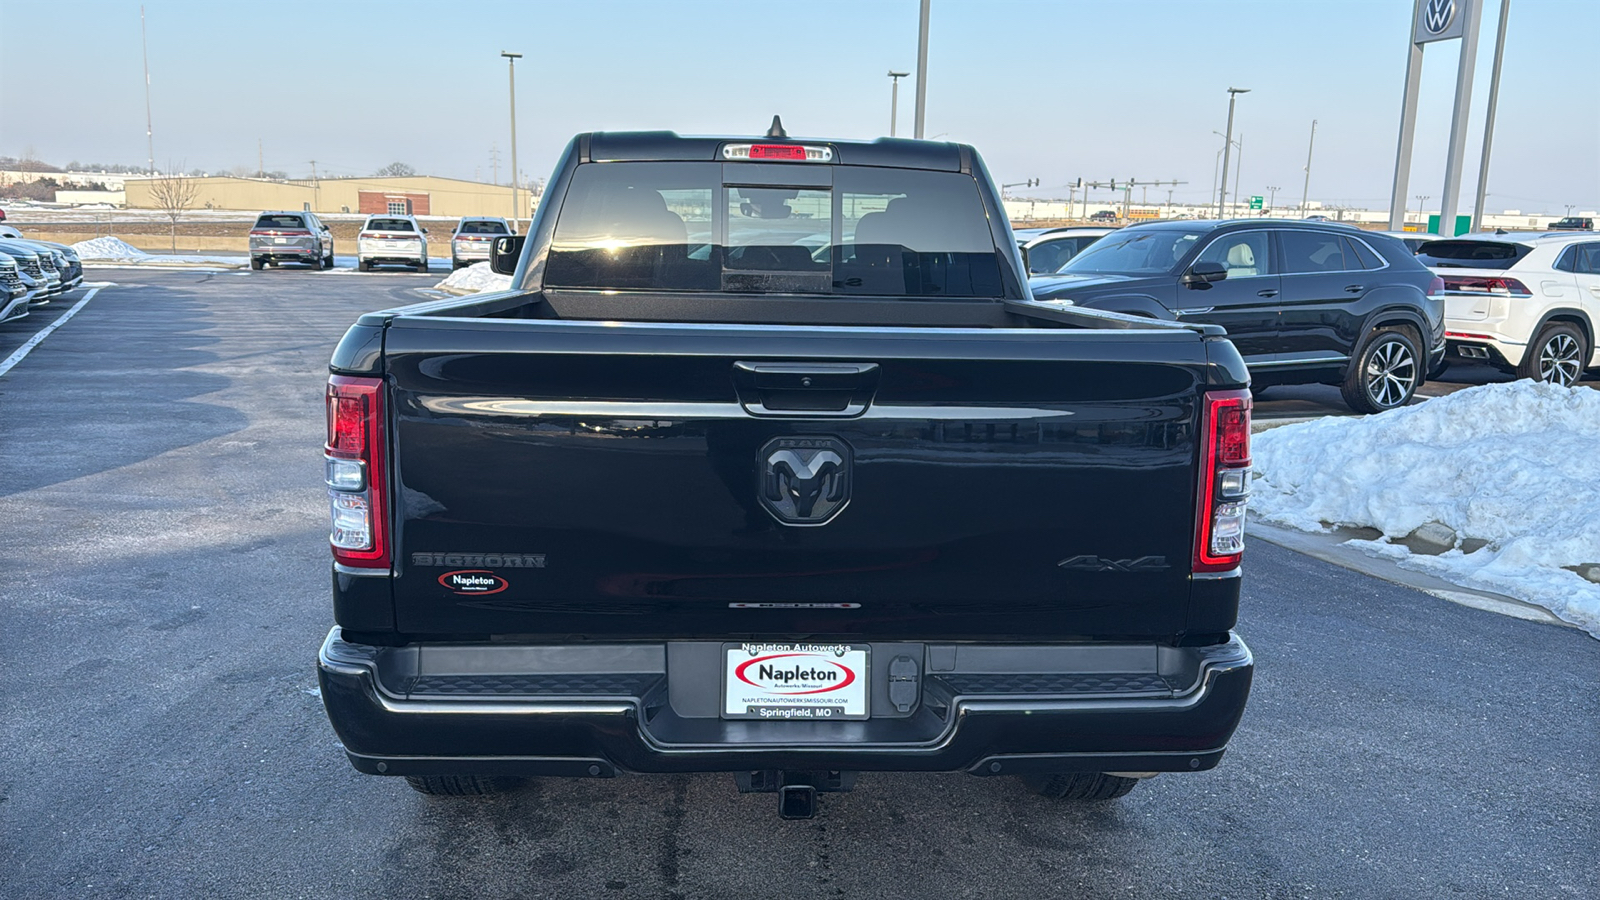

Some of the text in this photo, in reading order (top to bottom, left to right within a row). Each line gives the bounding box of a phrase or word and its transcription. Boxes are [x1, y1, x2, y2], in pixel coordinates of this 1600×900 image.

[411, 551, 547, 568] BIGHORN
[452, 574, 494, 586] Napleton
[741, 643, 852, 652] Napleton Autowerks
[758, 663, 837, 683] Napleton
[759, 707, 832, 718] Springfield, MO
